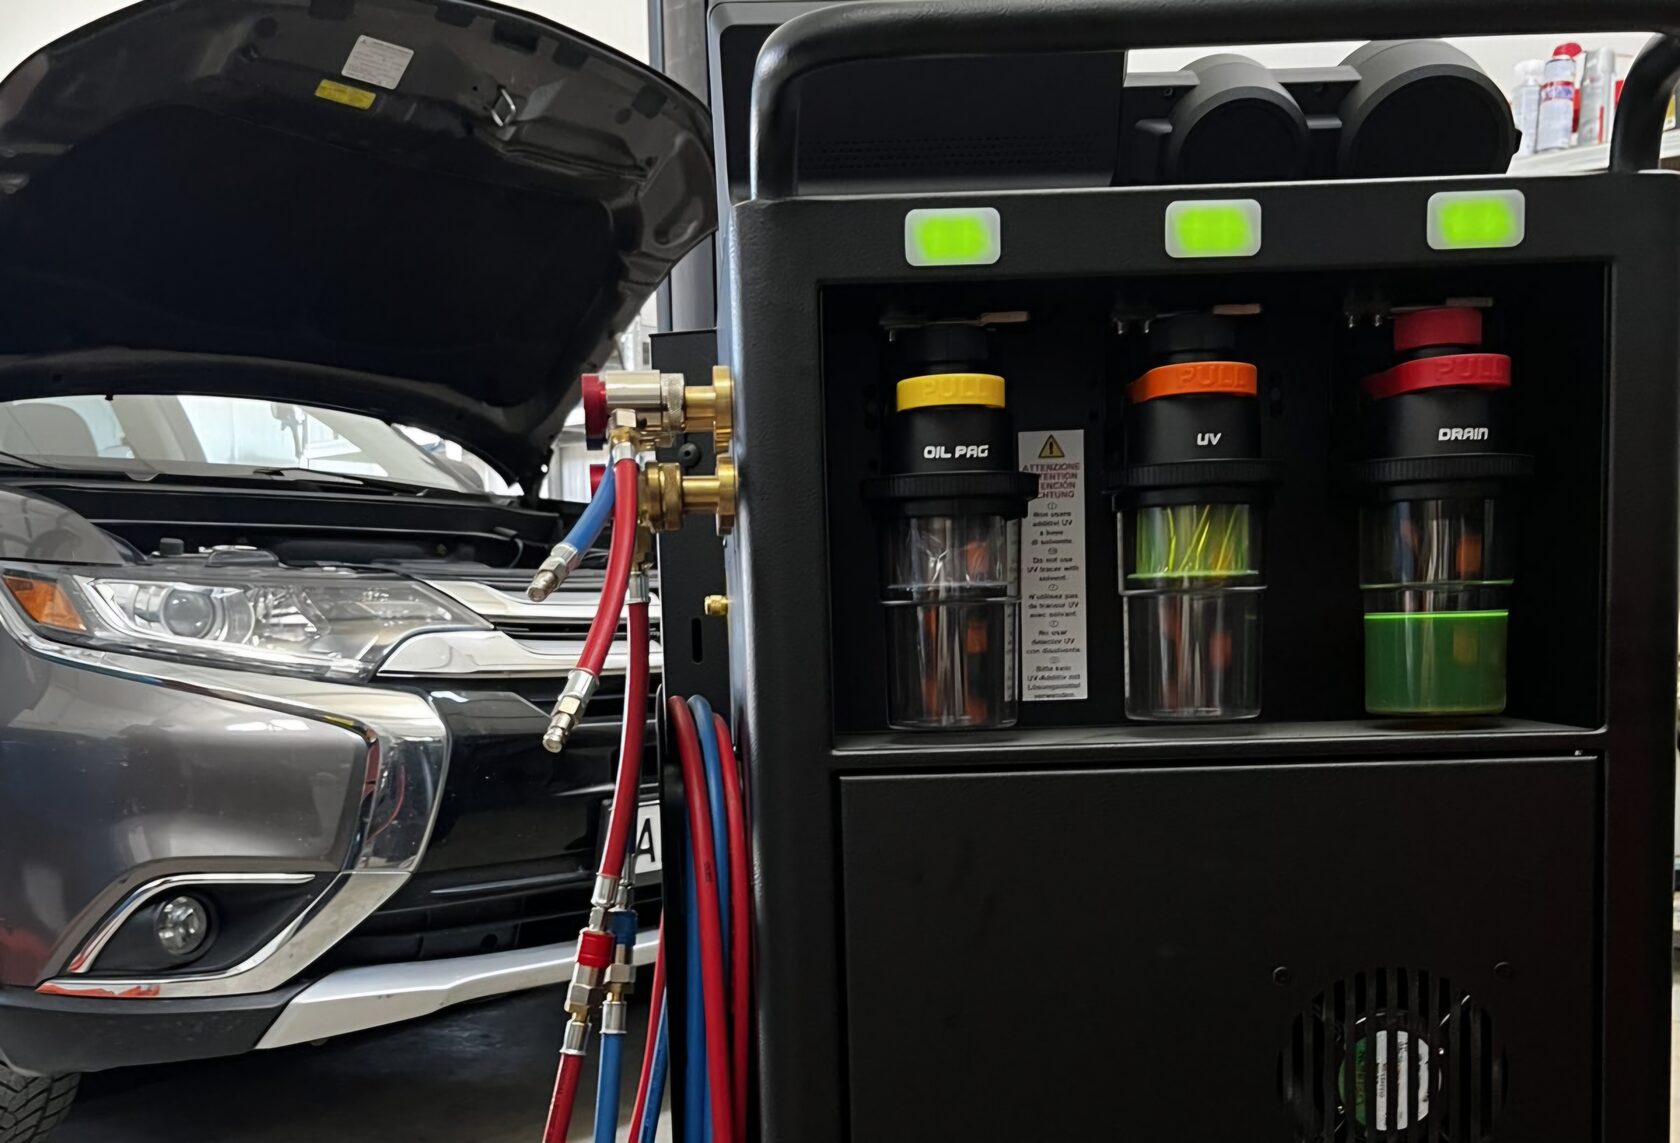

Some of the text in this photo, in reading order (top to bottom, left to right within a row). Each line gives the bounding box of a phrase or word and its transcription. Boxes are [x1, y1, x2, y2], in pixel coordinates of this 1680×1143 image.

[1436, 357, 1504, 381] PULL
[1178, 365, 1245, 388] PULL
[921, 377, 988, 400] PULL
[1197, 432, 1222, 446] UV
[1438, 427, 1489, 441] DRAIN
[923, 444, 989, 459] OIL PAG
[1040, 479, 1076, 490] ENCIÓN
[1038, 490, 1075, 499] CHTUNG
